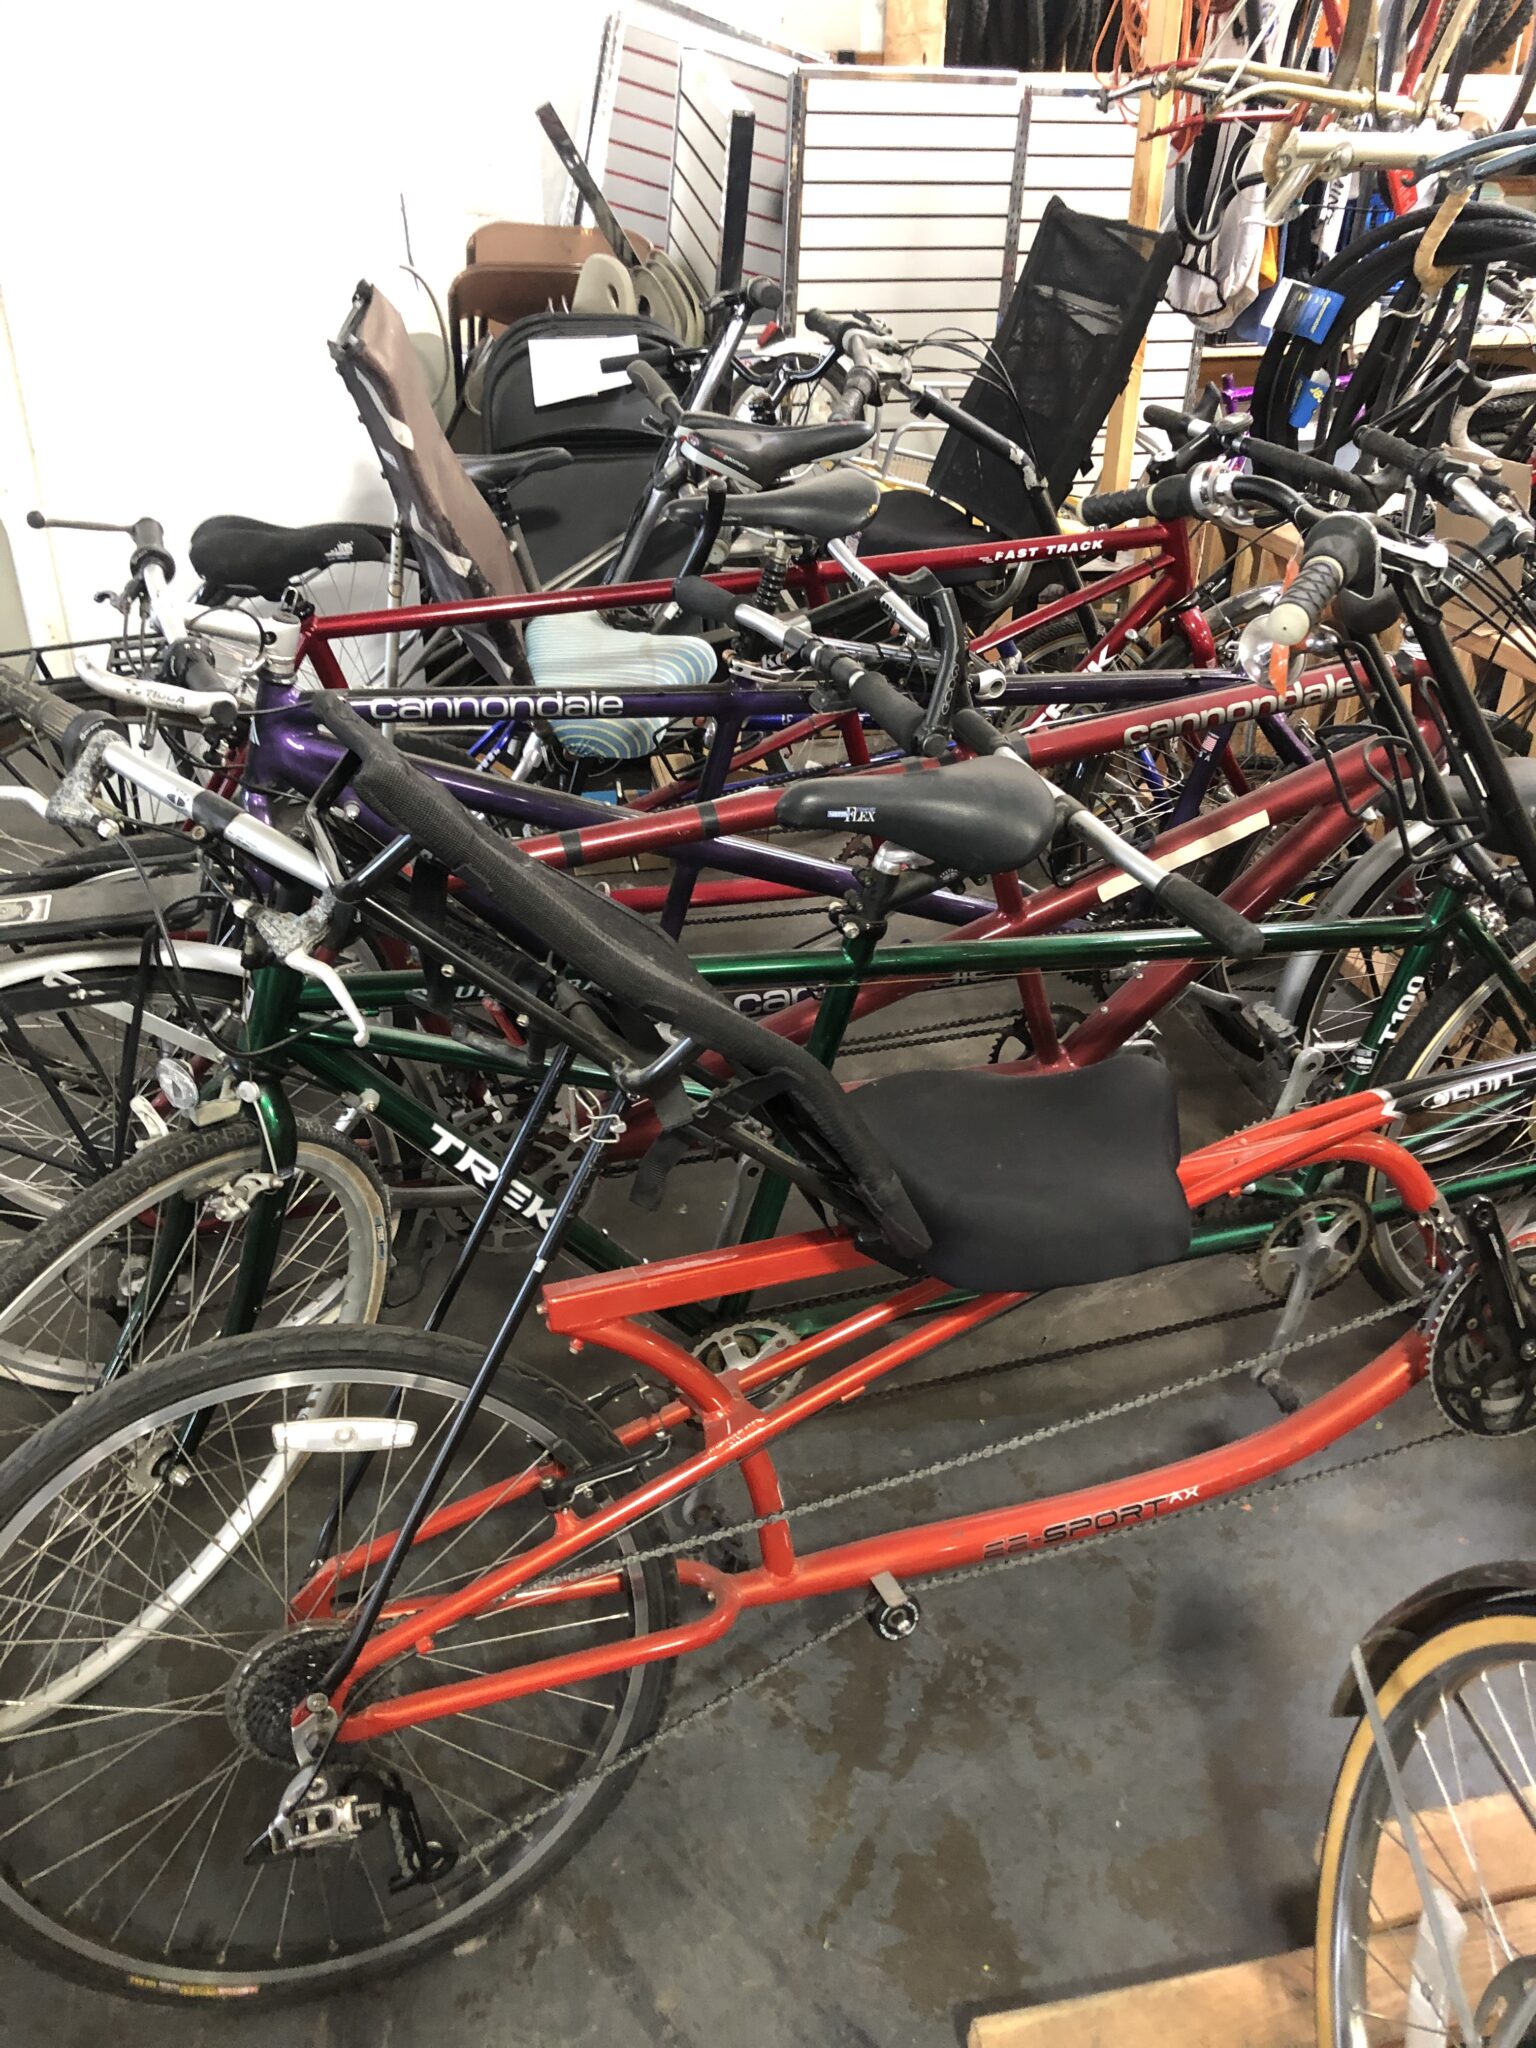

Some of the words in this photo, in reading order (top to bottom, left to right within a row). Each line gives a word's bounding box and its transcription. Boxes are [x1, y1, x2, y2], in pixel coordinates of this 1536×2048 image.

[994, 547, 1040, 561] FAST
[1046, 539, 1104, 555] TRACK
[370, 691, 624, 720] cannondale
[1123, 673, 1358, 746] cannondale
[1378, 976, 1425, 1044] T100
[430, 1122, 558, 1231] TREK
